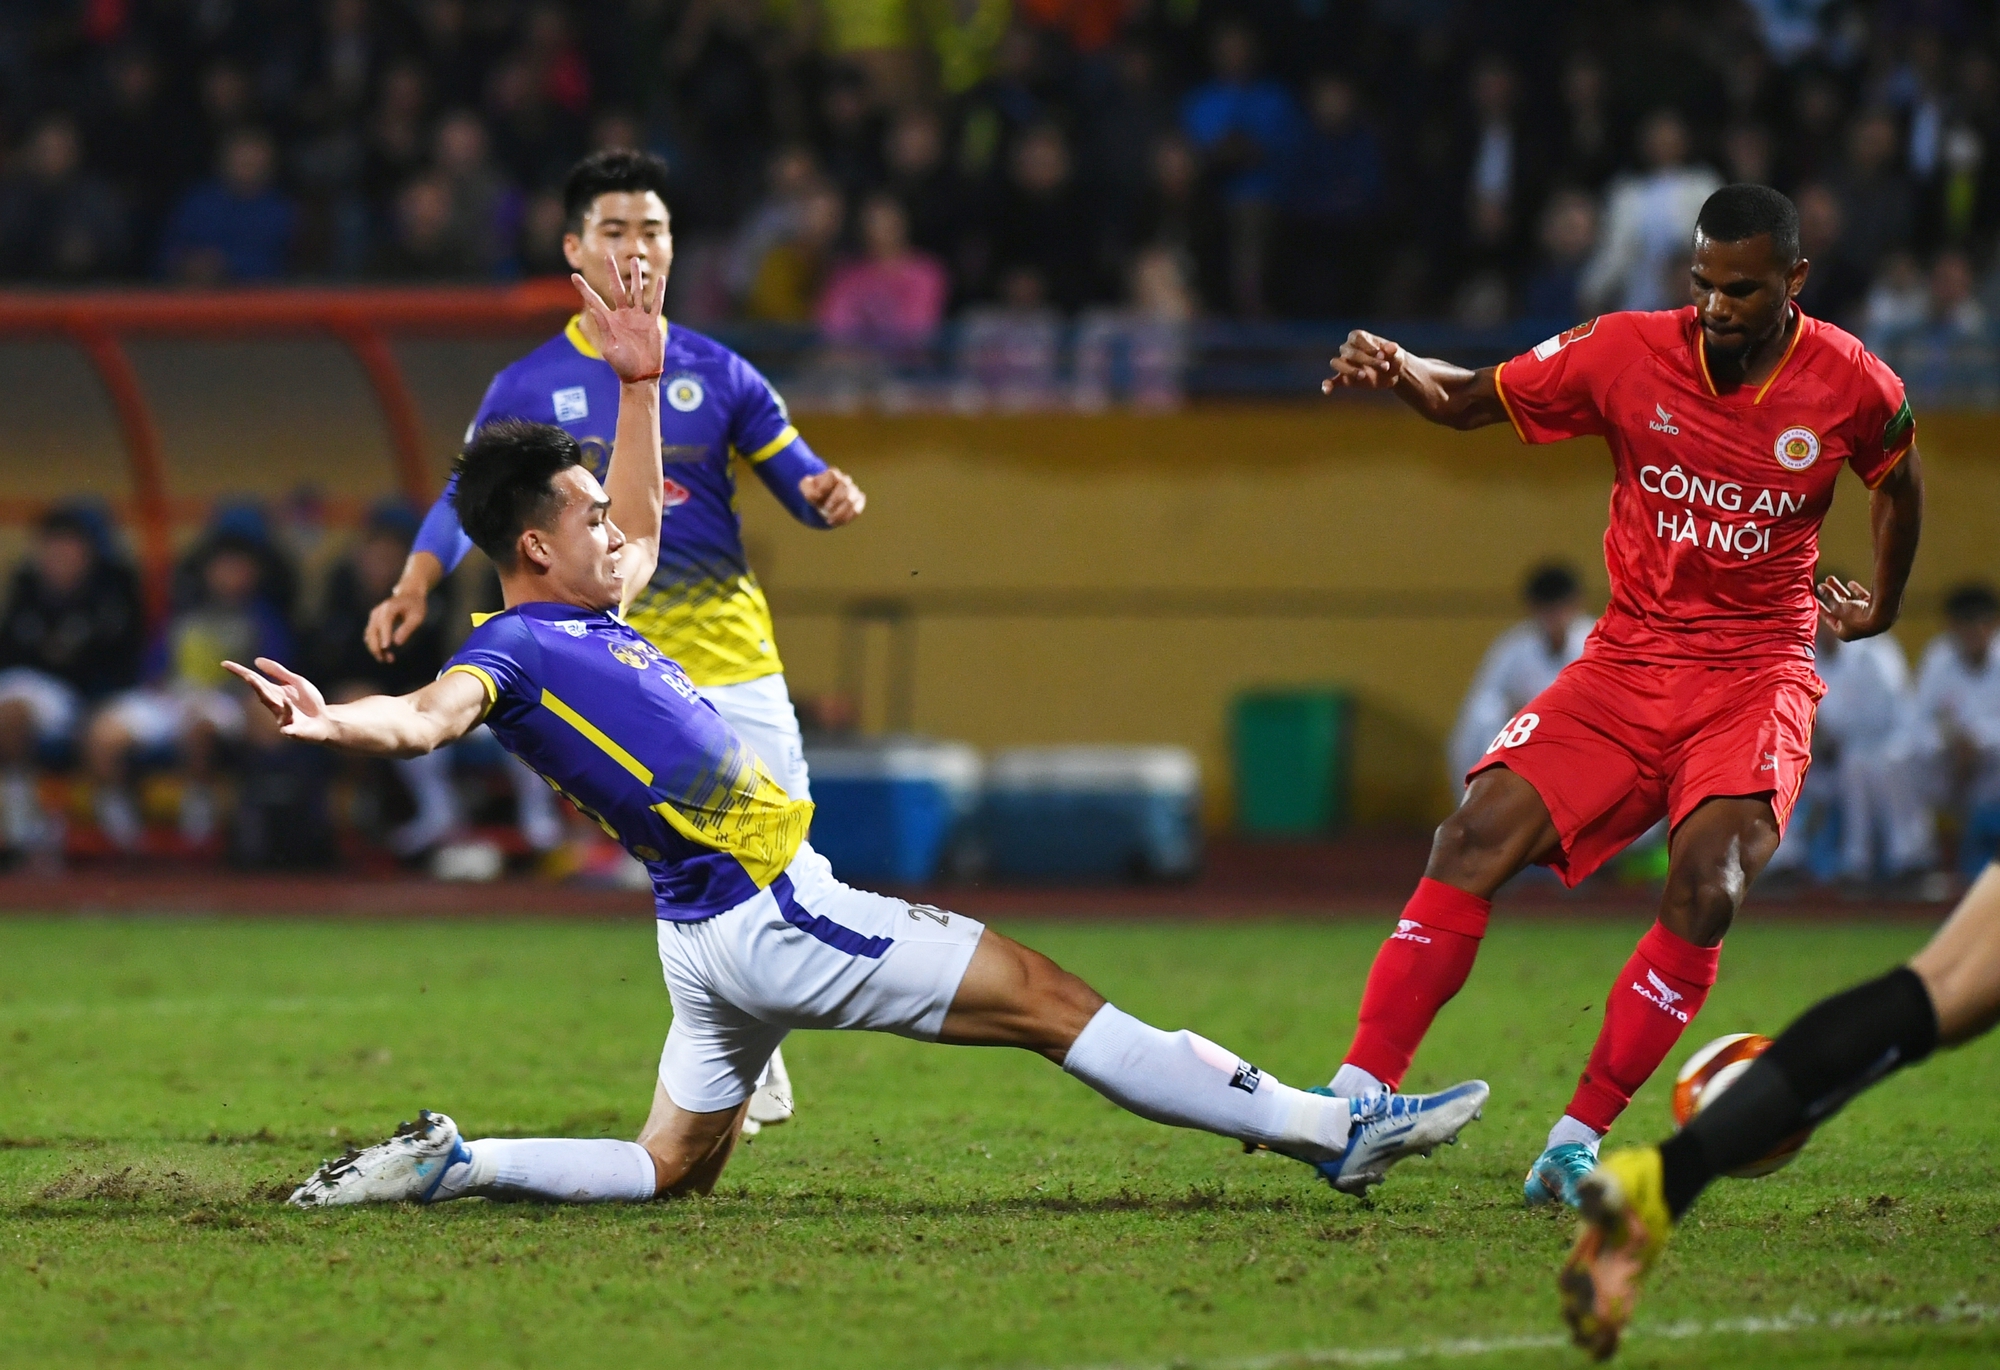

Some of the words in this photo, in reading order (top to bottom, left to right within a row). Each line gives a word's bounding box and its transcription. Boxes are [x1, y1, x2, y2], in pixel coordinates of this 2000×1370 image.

[1639, 464, 1742, 511] CÔNG
[1749, 489, 1806, 517] AN
[1657, 508, 1699, 547] HÀ
[1706, 521, 1770, 560] NỘI
[1485, 712, 1540, 755] 68
[1631, 981, 1688, 1023] KAMITO
